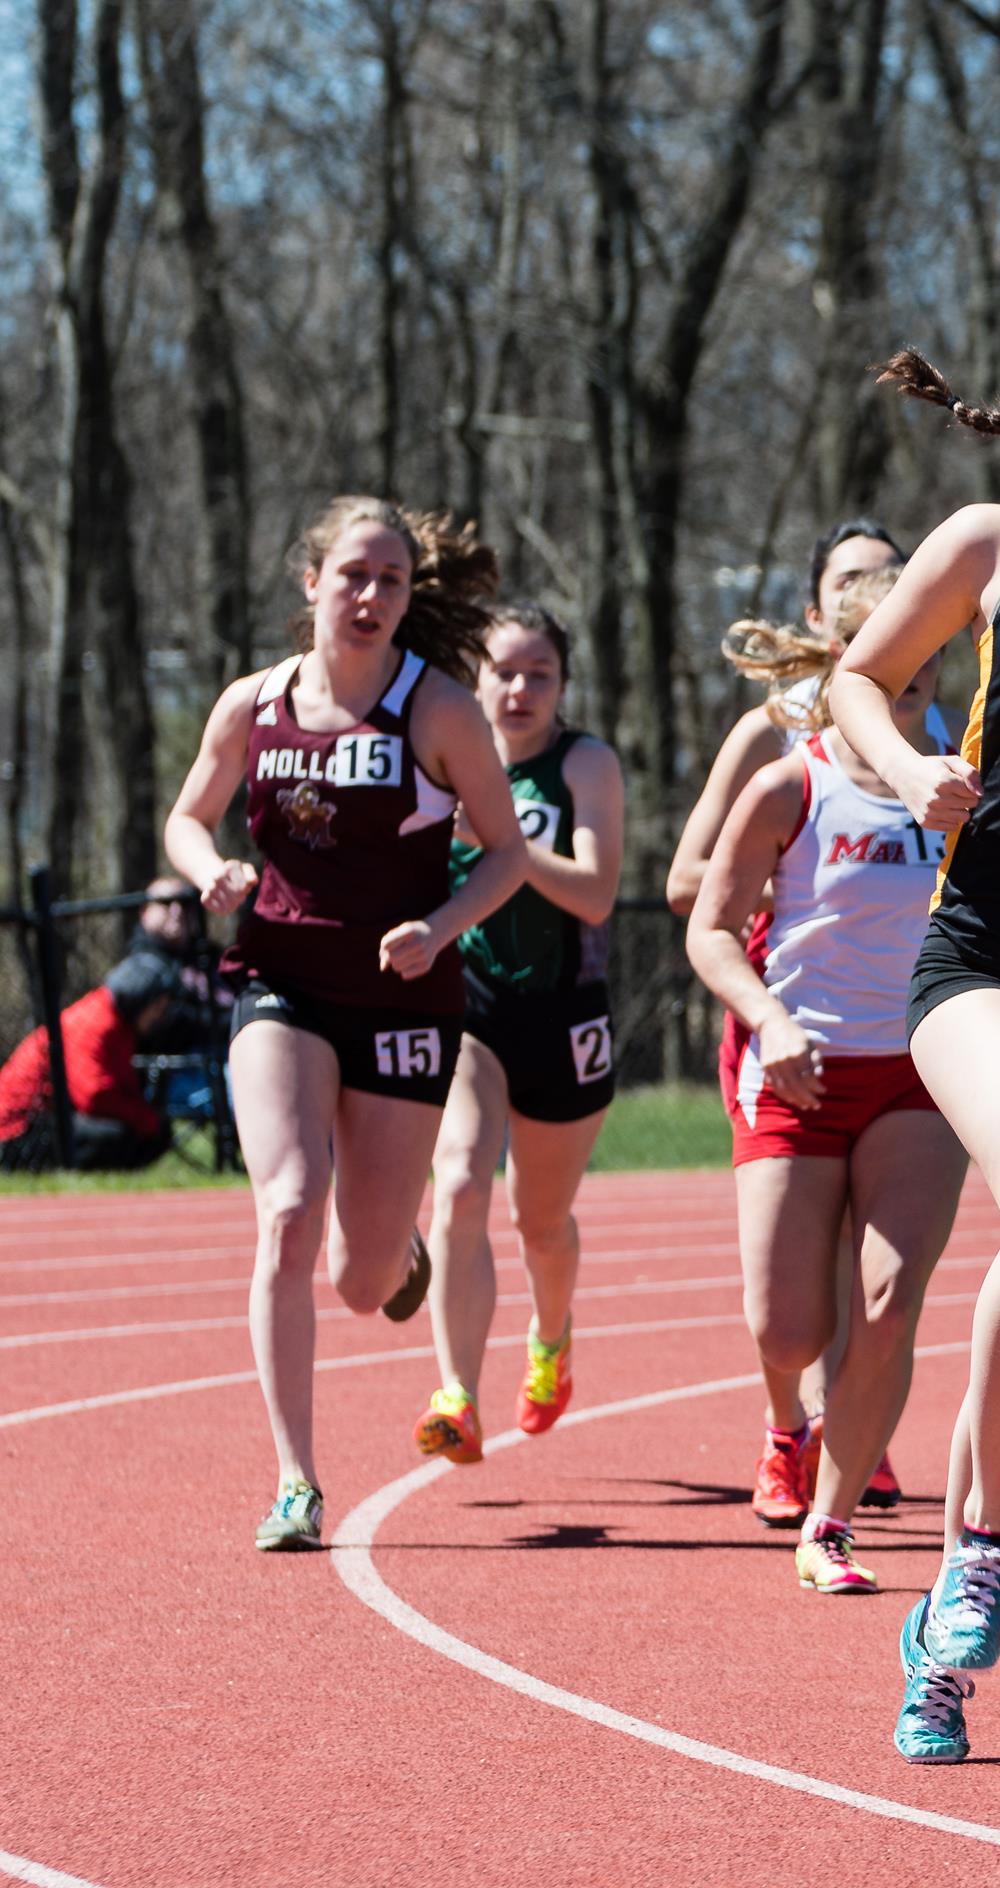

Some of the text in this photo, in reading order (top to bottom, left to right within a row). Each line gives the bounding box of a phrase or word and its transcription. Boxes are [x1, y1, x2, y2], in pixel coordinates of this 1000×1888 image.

[343, 739, 392, 780] 15
[520, 809, 549, 841] 2
[381, 1032, 433, 1077] 15
[578, 1027, 608, 1076] 2
